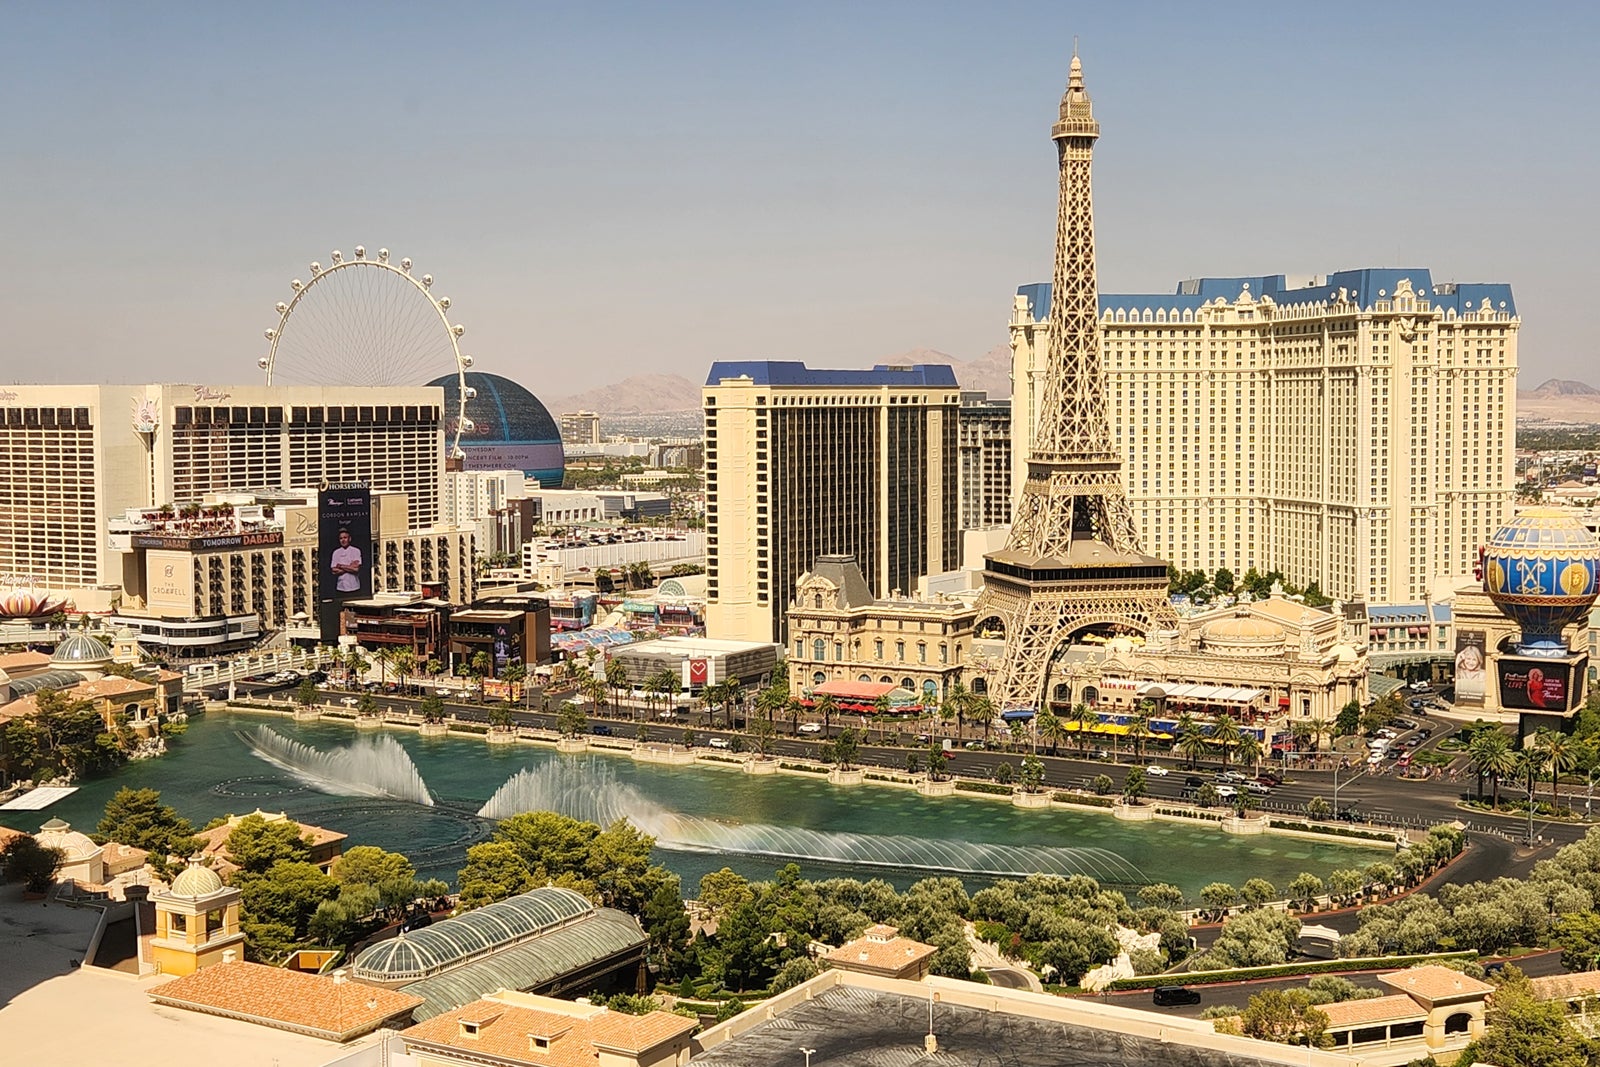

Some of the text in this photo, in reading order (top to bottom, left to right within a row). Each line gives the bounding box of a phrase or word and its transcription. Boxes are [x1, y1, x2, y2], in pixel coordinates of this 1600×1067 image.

[163, 539, 190, 549] DABABY
[203, 537, 241, 547] TOMORROW
[242, 533, 281, 546] DABABY
